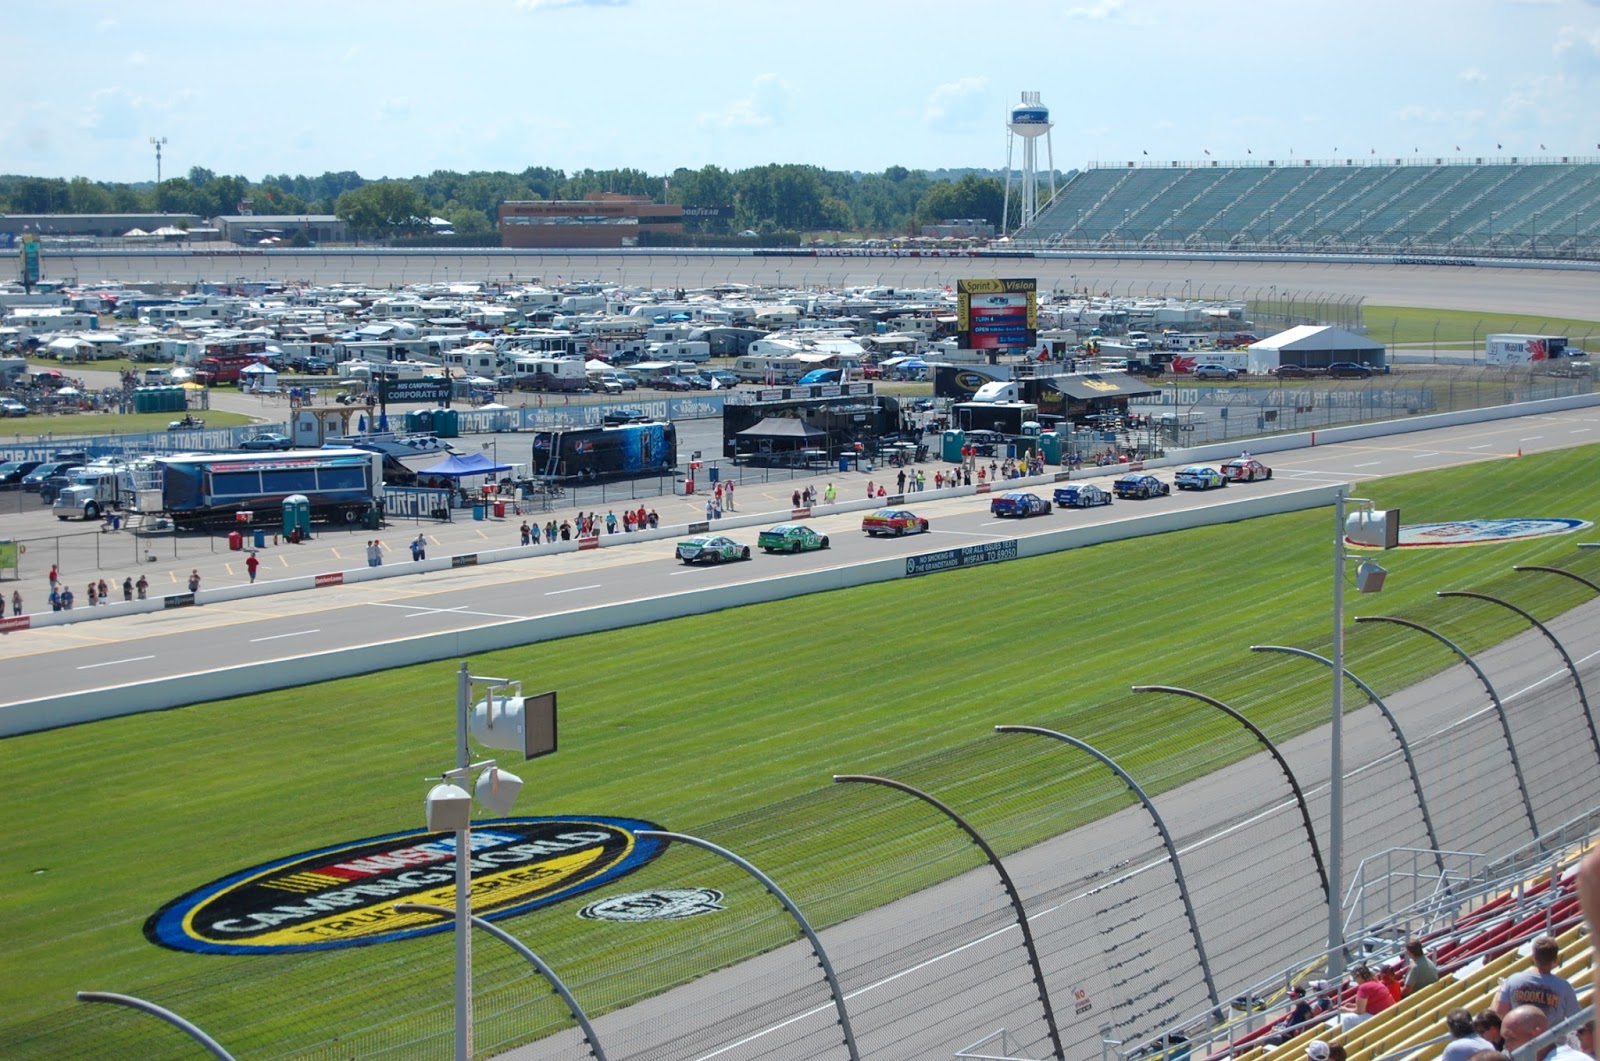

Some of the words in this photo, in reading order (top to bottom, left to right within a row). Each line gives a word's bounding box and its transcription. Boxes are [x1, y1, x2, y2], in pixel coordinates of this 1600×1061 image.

[816, 249, 909, 257] MICHIGAN
[967, 281, 990, 291] Sprint
[1006, 281, 1034, 290] Vision
[388, 390, 437, 399] CORPORATE
[438, 390, 449, 398] RV
[805, 535, 815, 545] 13
[962, 547, 973, 556] FOR
[973, 545, 983, 554] ALL
[984, 542, 1001, 551] ISSUES
[987, 551, 996, 560] TO
[997, 547, 1016, 559] 69050
[919, 556, 928, 564] NO
[928, 552, 949, 562] SMOKING
[949, 551, 955, 559] IN
[915, 564, 925, 572] THE
[925, 558, 958, 571] GRANDSTANDS
[333, 830, 521, 875] NASCAR
[212, 870, 453, 933] CAMPING
[430, 830, 612, 873] WORLD
[293, 901, 414, 936] TRUC
[430, 867, 562, 899] SRIES
[1513, 988, 1559, 1008] BROOKLYN
